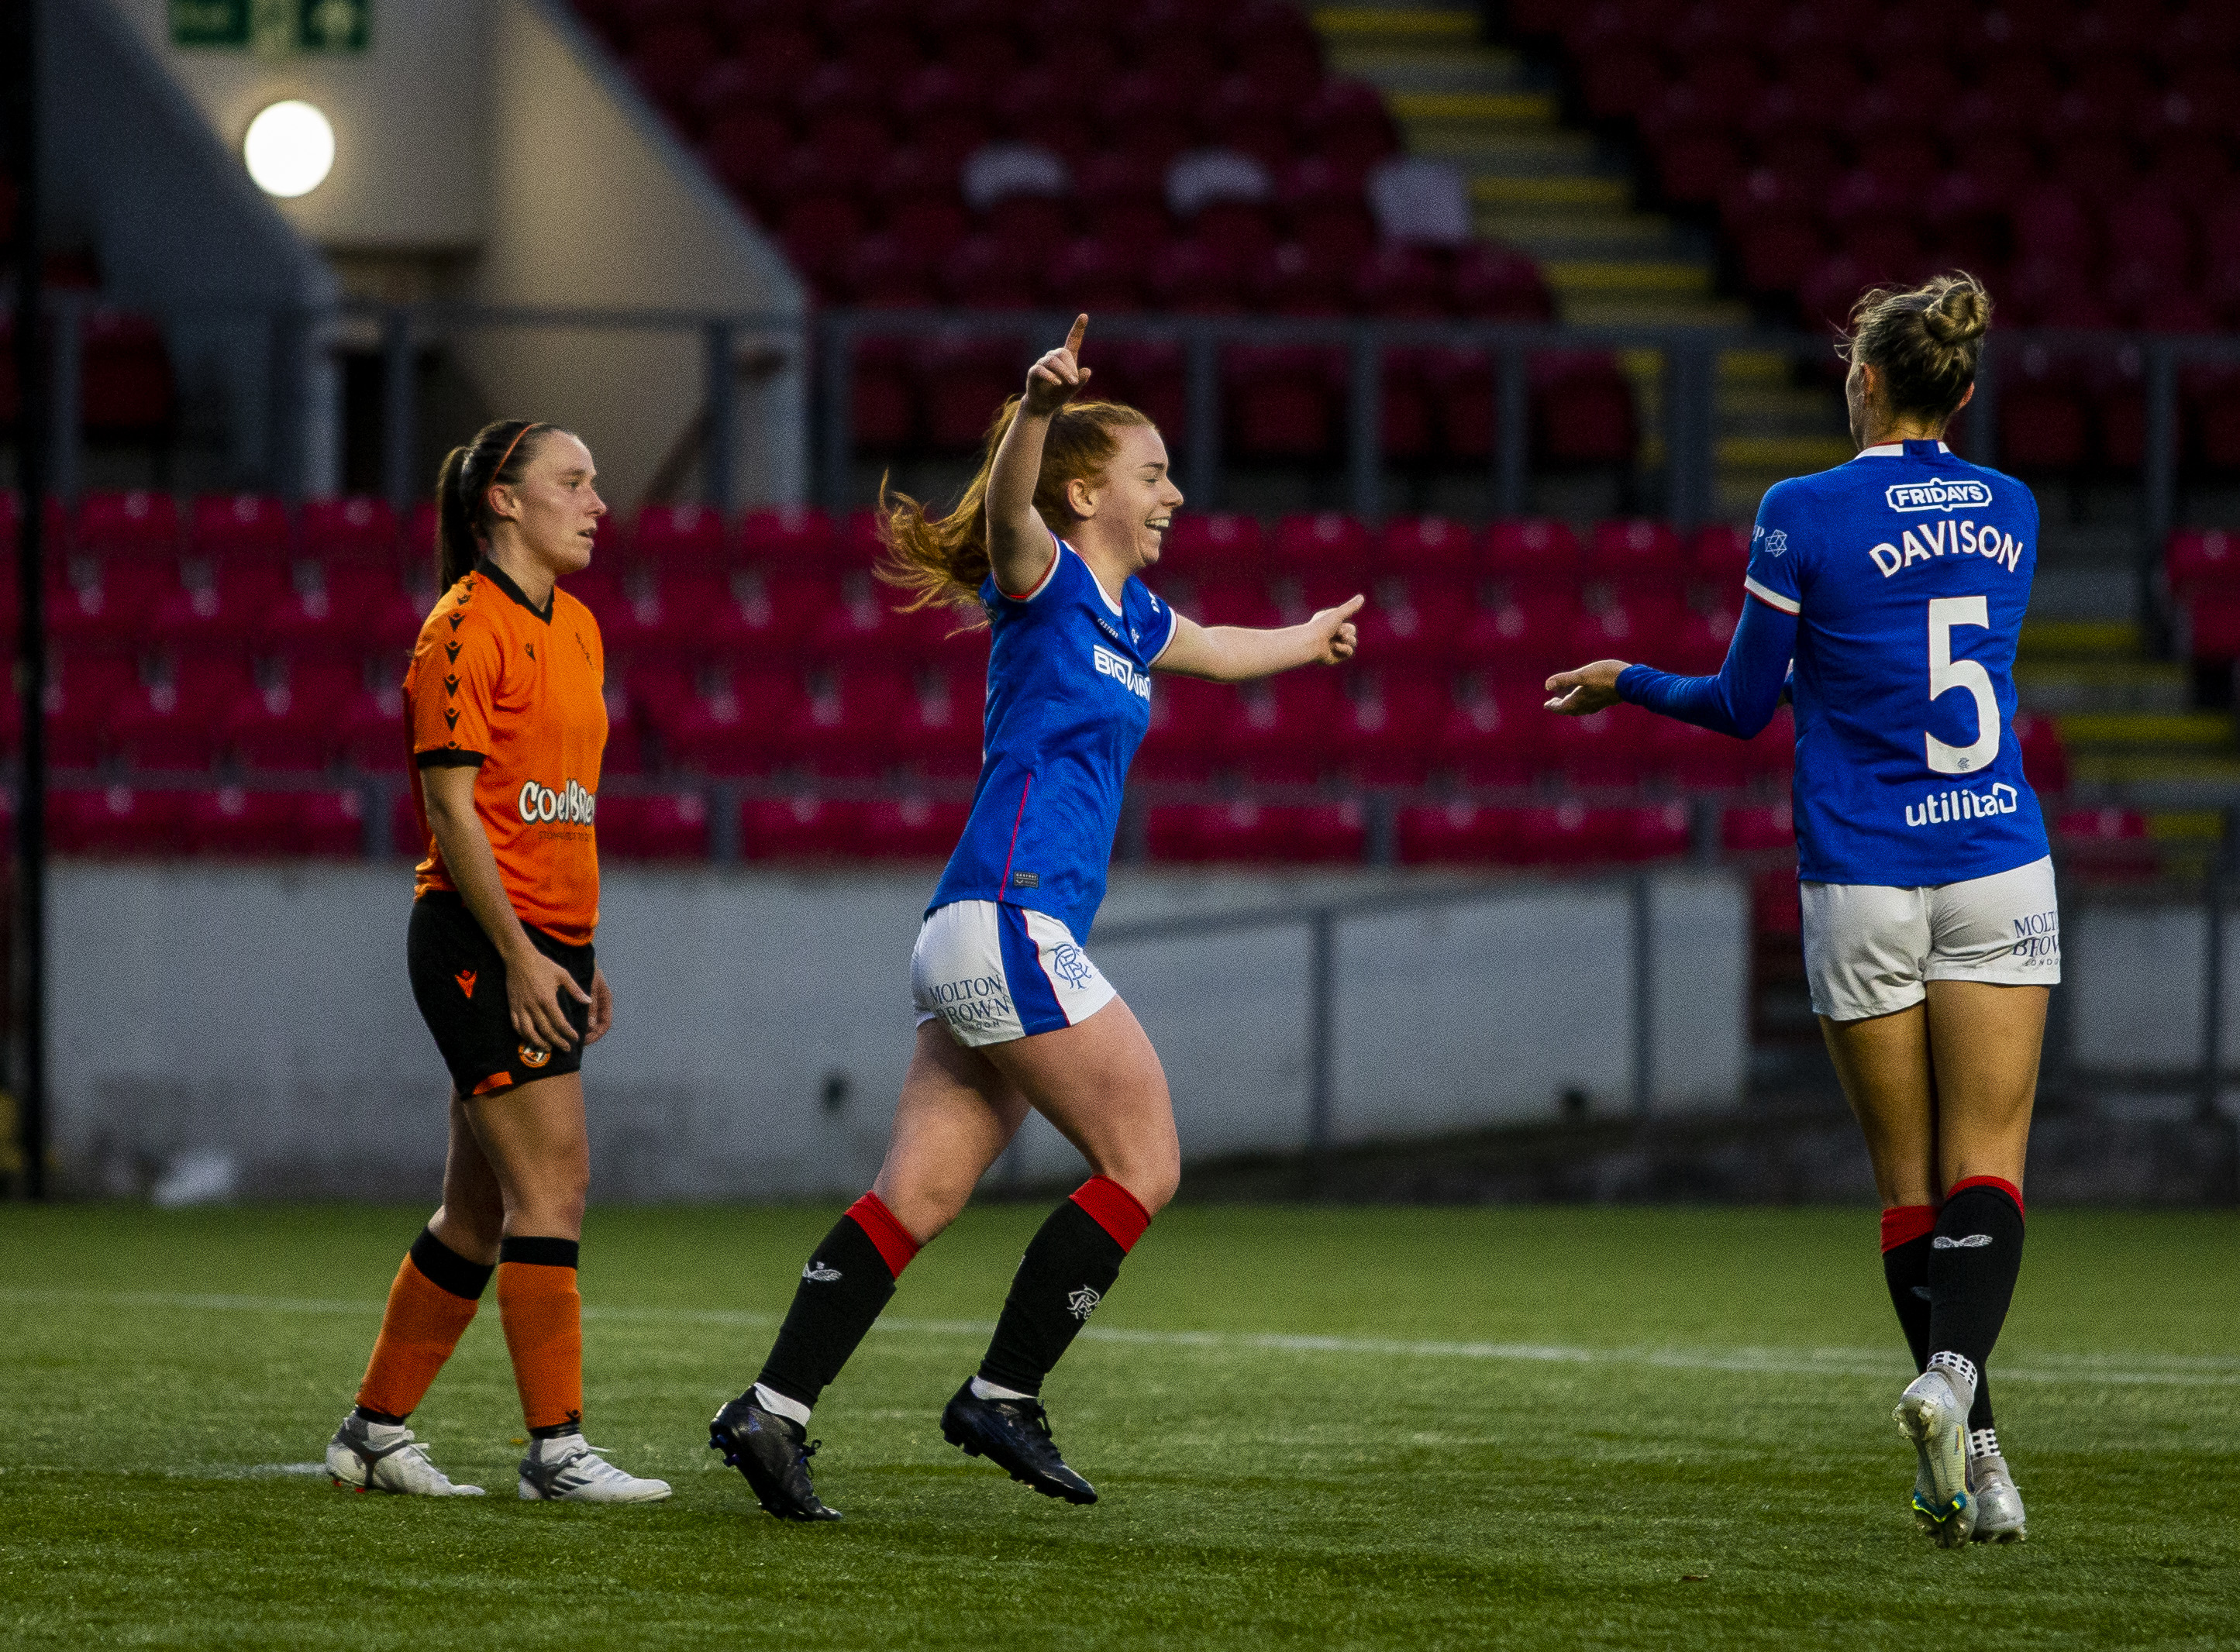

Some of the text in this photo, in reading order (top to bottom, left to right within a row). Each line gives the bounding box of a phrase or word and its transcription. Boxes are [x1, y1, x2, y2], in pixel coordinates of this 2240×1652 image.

[1895, 485, 1984, 507] FRIDAYS
[1869, 520, 2024, 579] DAVISON
[1924, 595, 2000, 774] 5
[1904, 787, 2001, 827] utilita
[2013, 910, 2058, 938] MOLT
[929, 974, 1003, 1005] MOLTON
